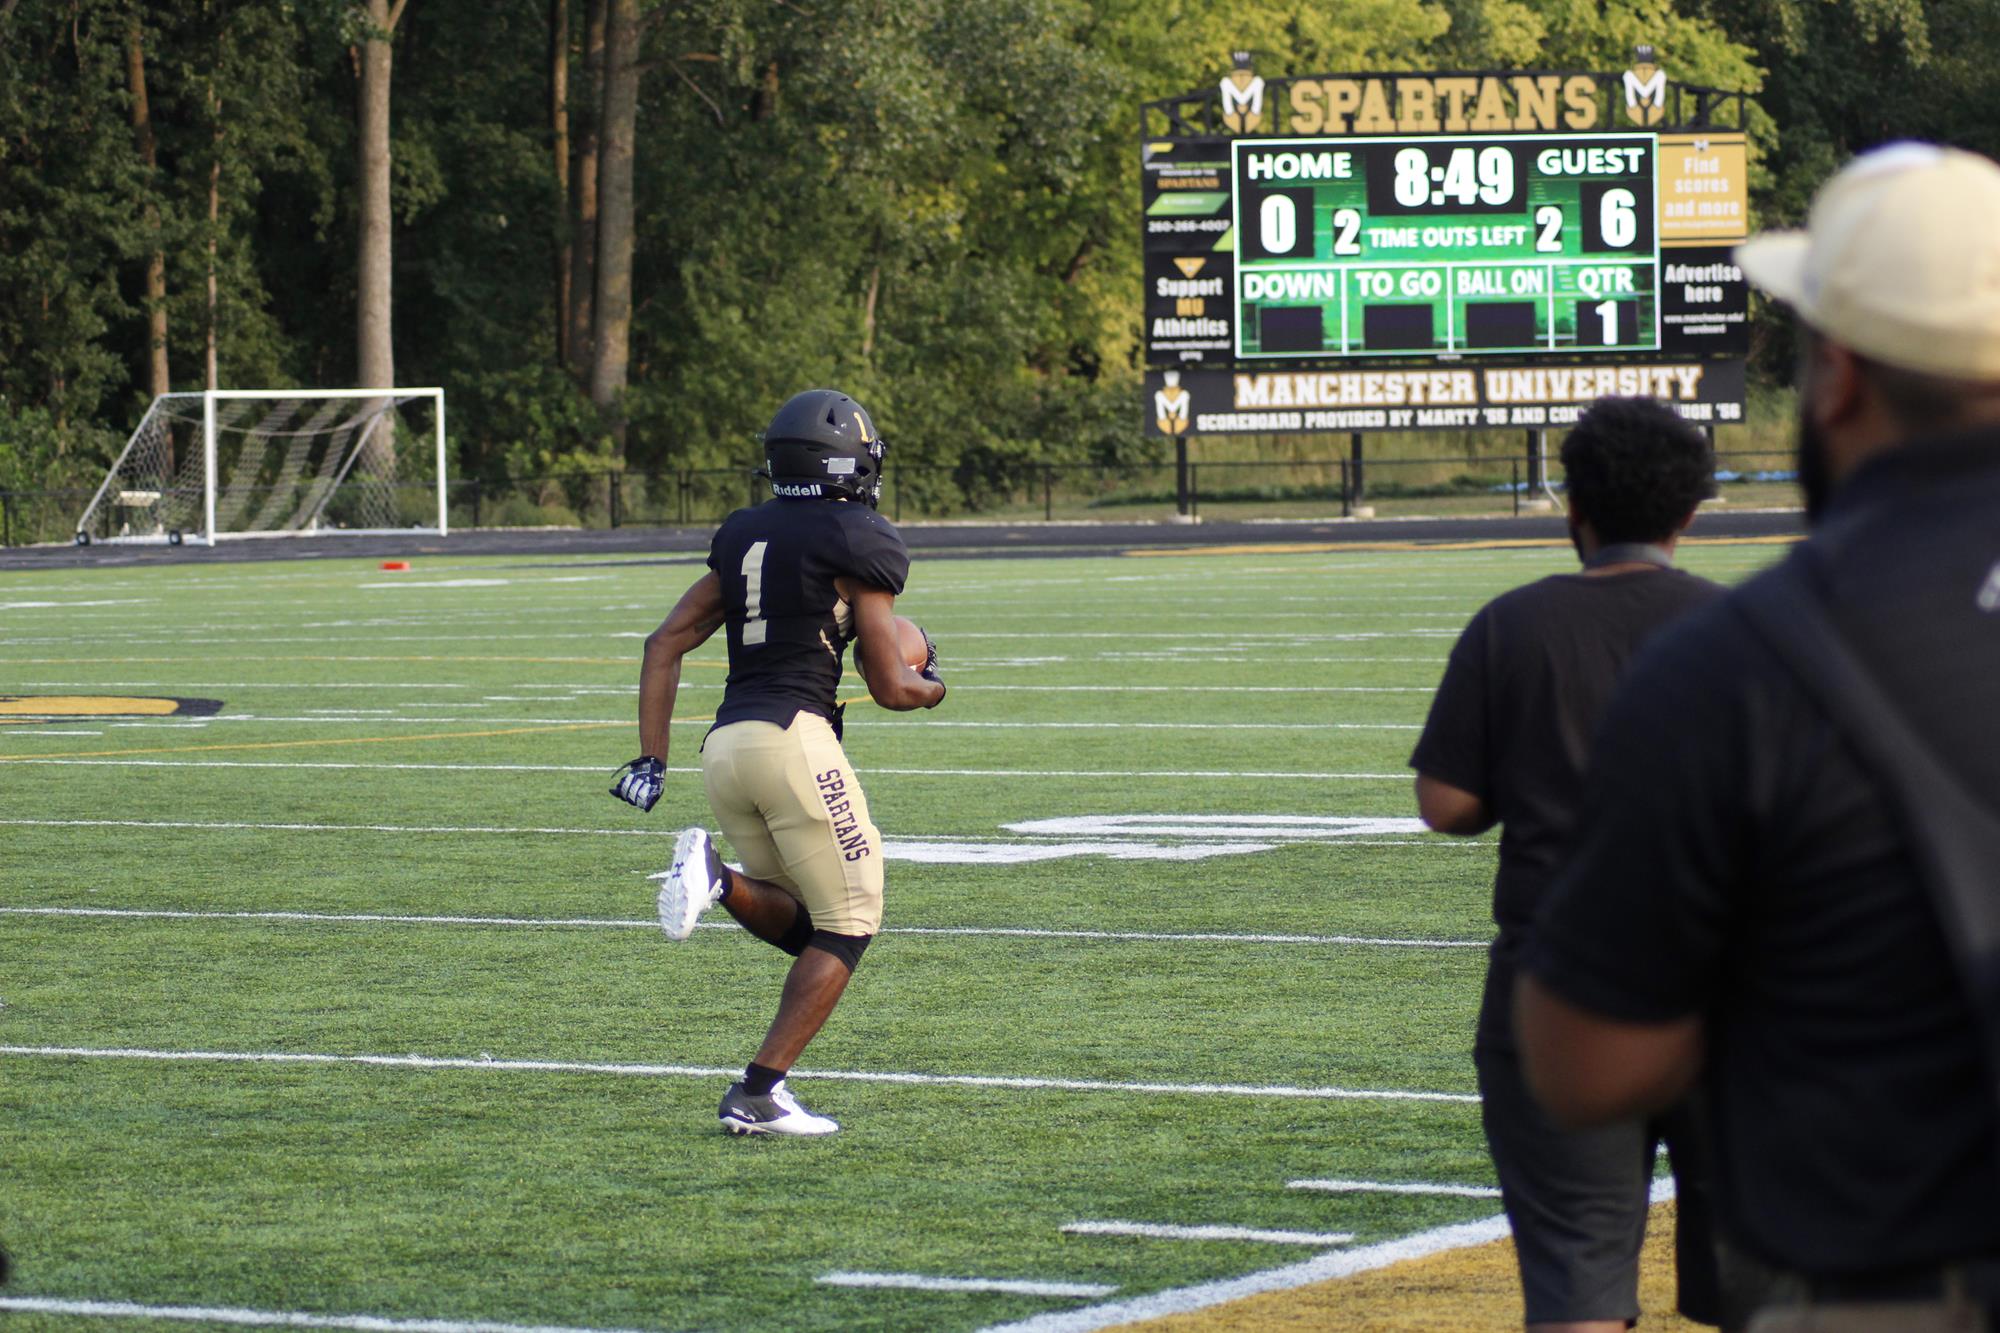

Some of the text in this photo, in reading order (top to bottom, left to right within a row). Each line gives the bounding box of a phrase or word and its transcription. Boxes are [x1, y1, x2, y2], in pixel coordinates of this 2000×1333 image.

[1290, 75, 1597, 134] SPARTANS
[1247, 153, 1353, 180] HOME
[1536, 147, 1646, 176] GUEST
[1683, 155, 1720, 174] Find
[1394, 146, 1515, 207] 8:49
[1674, 179, 1729, 194] scores
[1600, 188, 1636, 248] 6
[1665, 199, 1739, 217] and more
[1260, 193, 1297, 254] 0
[1334, 208, 1361, 255] 2
[1369, 225, 1527, 249] TIME OUTS LEFT
[1536, 205, 1563, 252] 2
[1156, 276, 1223, 297] Support
[1243, 272, 1335, 300] DOWN
[1355, 271, 1441, 297] TO GO
[1456, 269, 1543, 295] BALL ON
[1577, 267, 1635, 299] QTR
[1664, 263, 1743, 283] Advertise
[1684, 284, 1723, 303] here
[1152, 317, 1229, 337] Athletics
[1594, 299, 1619, 346] 1
[1234, 364, 1704, 410] MANCHESTER UNIVERSITY
[1196, 411, 1302, 432] SCOREBOARD
[1304, 409, 1386, 429] PROVIDED
[1388, 408, 1414, 427] BY
[1416, 406, 1479, 427] MARTY
[1511, 405, 1546, 425] AND
[772, 483, 822, 497] Riddell
[741, 541, 768, 646] 1
[816, 768, 870, 862] SPARTANS
